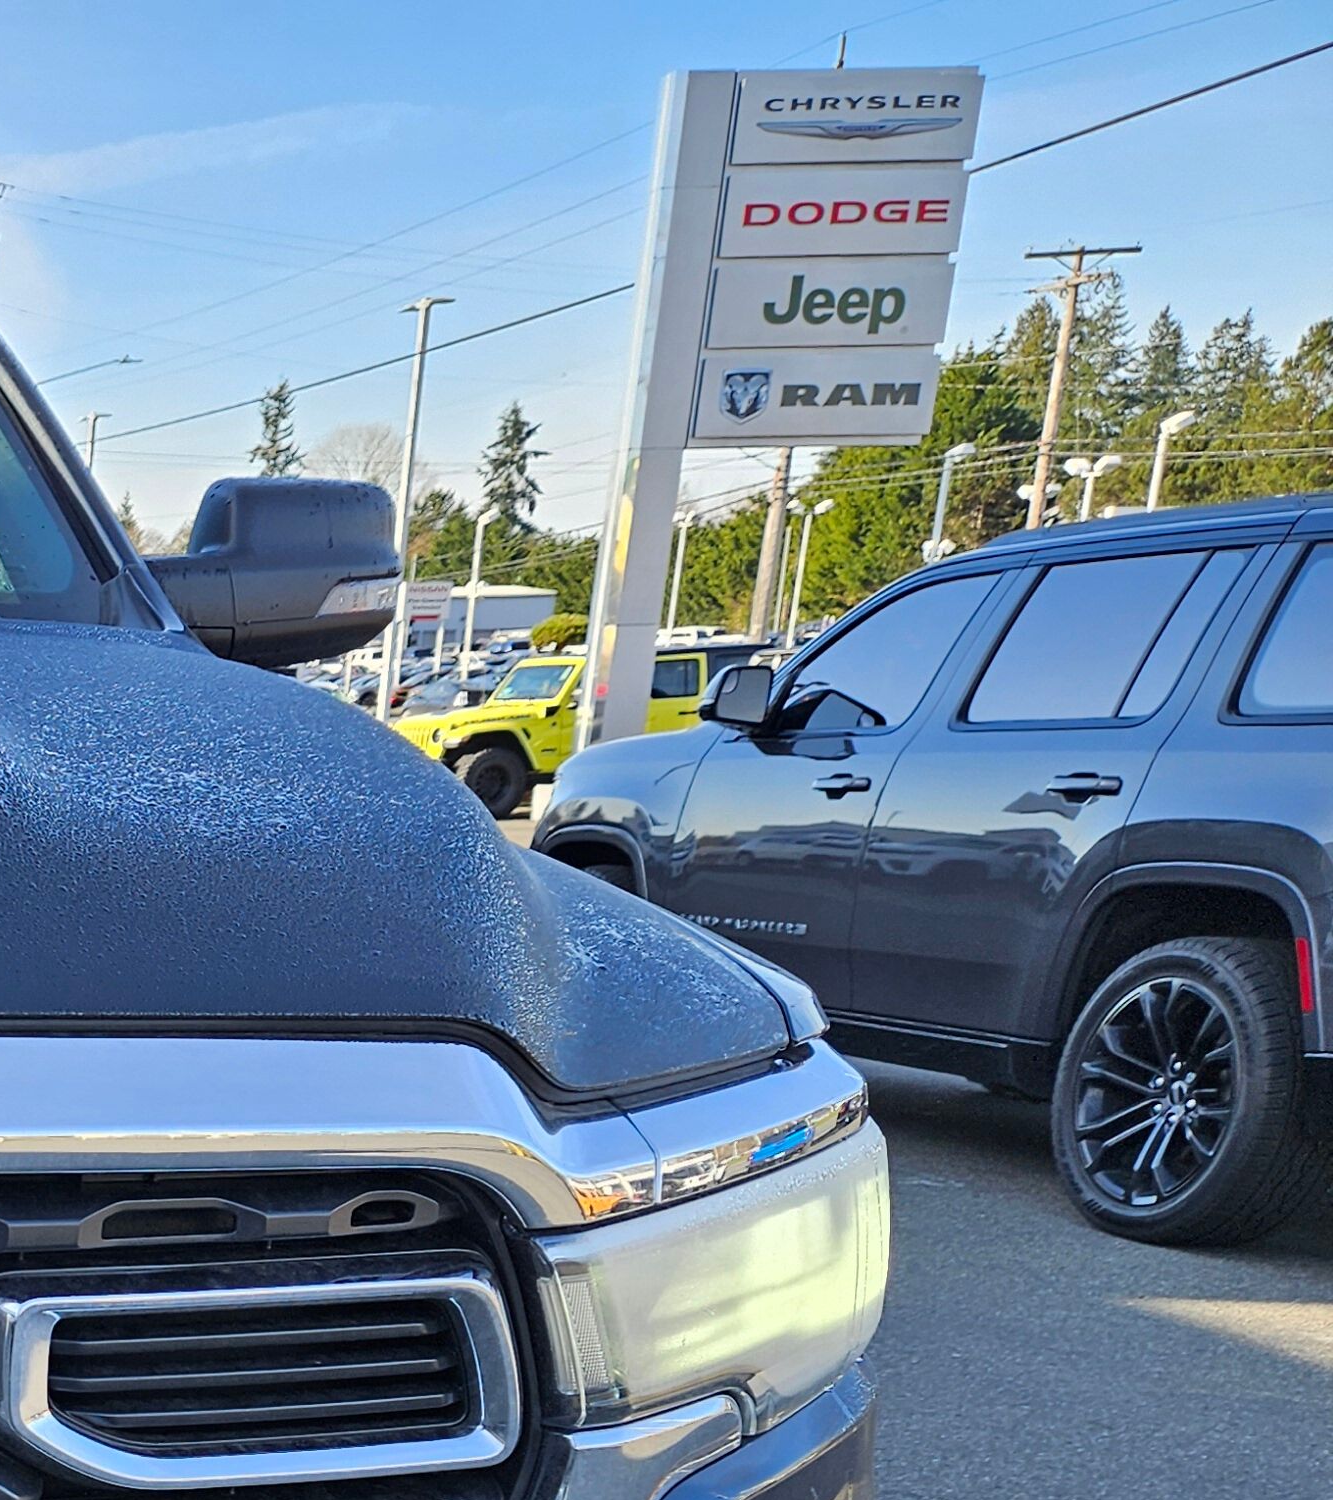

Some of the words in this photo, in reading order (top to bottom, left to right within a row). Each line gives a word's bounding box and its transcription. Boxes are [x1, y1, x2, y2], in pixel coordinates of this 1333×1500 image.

[764, 95, 961, 112] CHRYSLER
[743, 200, 950, 227] DODGE
[763, 275, 906, 334] Jeep
[780, 383, 922, 407] RAM
